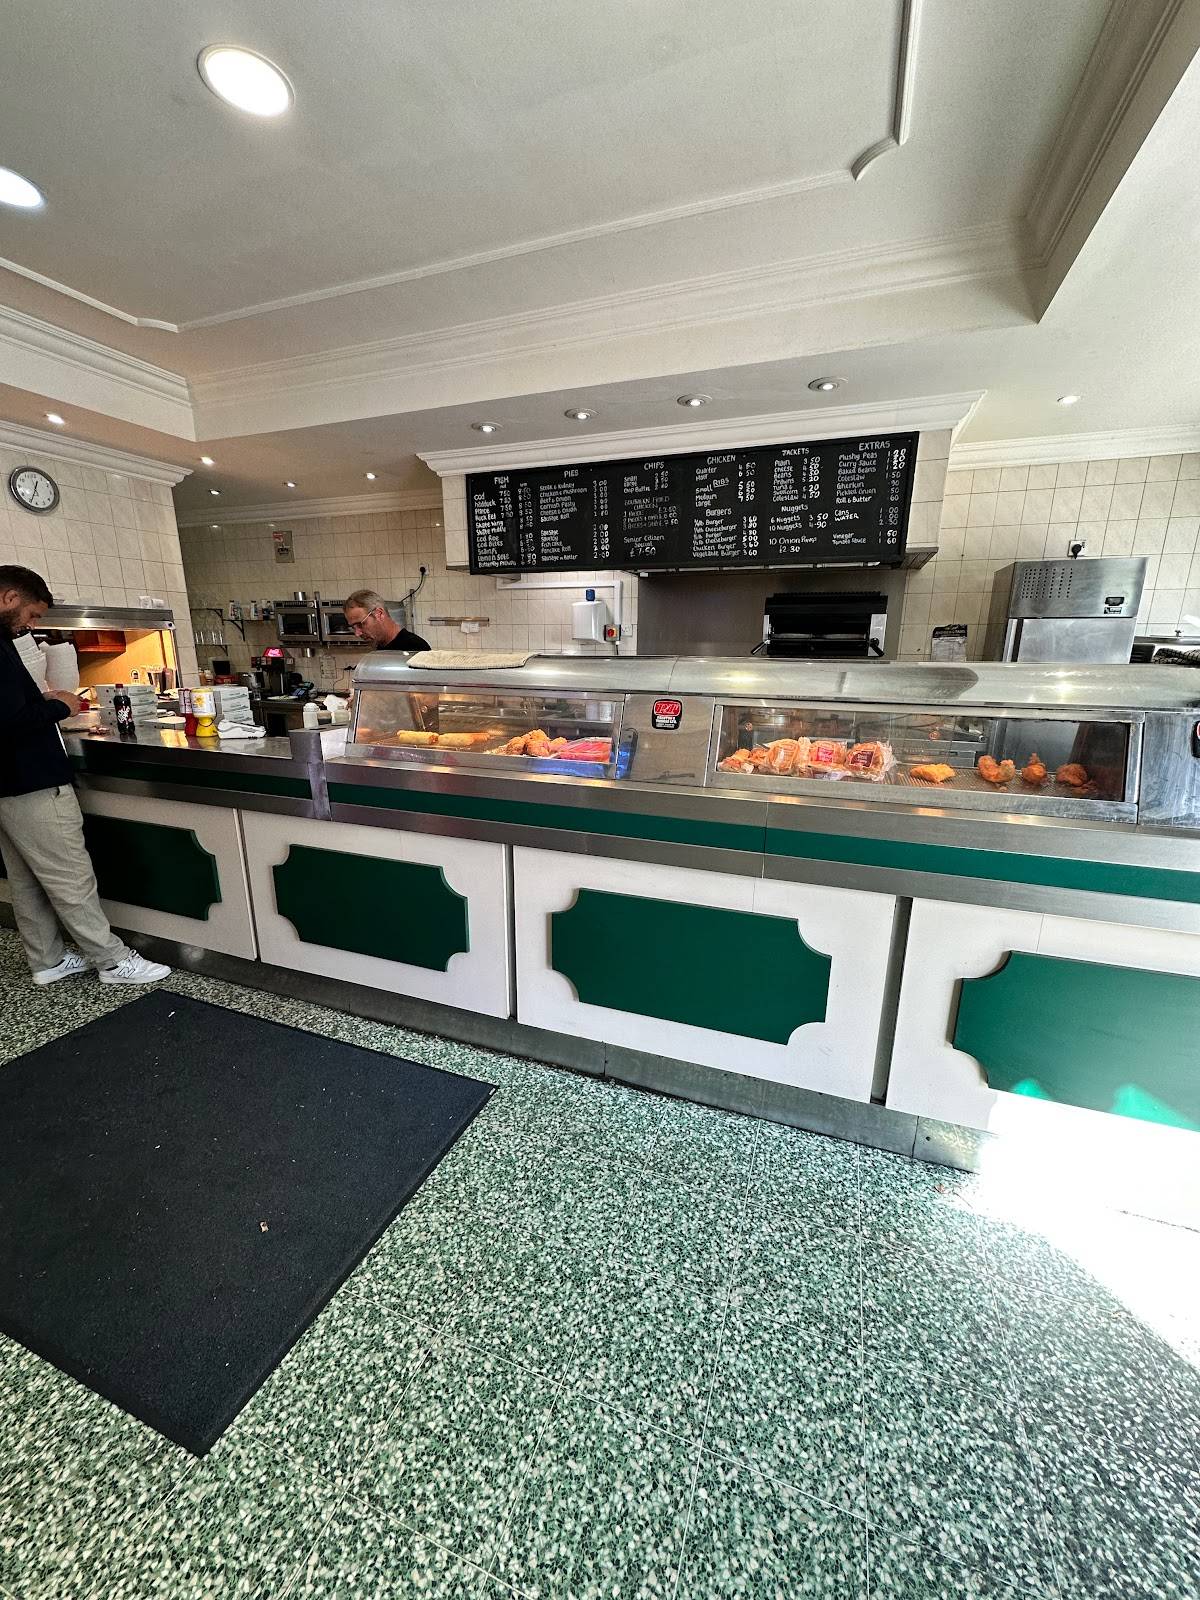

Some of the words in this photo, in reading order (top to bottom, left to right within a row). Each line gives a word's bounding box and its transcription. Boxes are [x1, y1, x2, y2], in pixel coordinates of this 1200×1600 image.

[859, 440, 891, 451] EXTRAS
[782, 447, 810, 456] JACKETS
[707, 455, 737, 465] CHICKEN
[644, 461, 665, 470] CHIPS
[563, 469, 579, 478] PIES
[705, 508, 732, 516] Burgers
[781, 503, 809, 514] Nuggets
[776, 514, 801, 524] Nuggets
[777, 522, 802, 531] Nuggets
